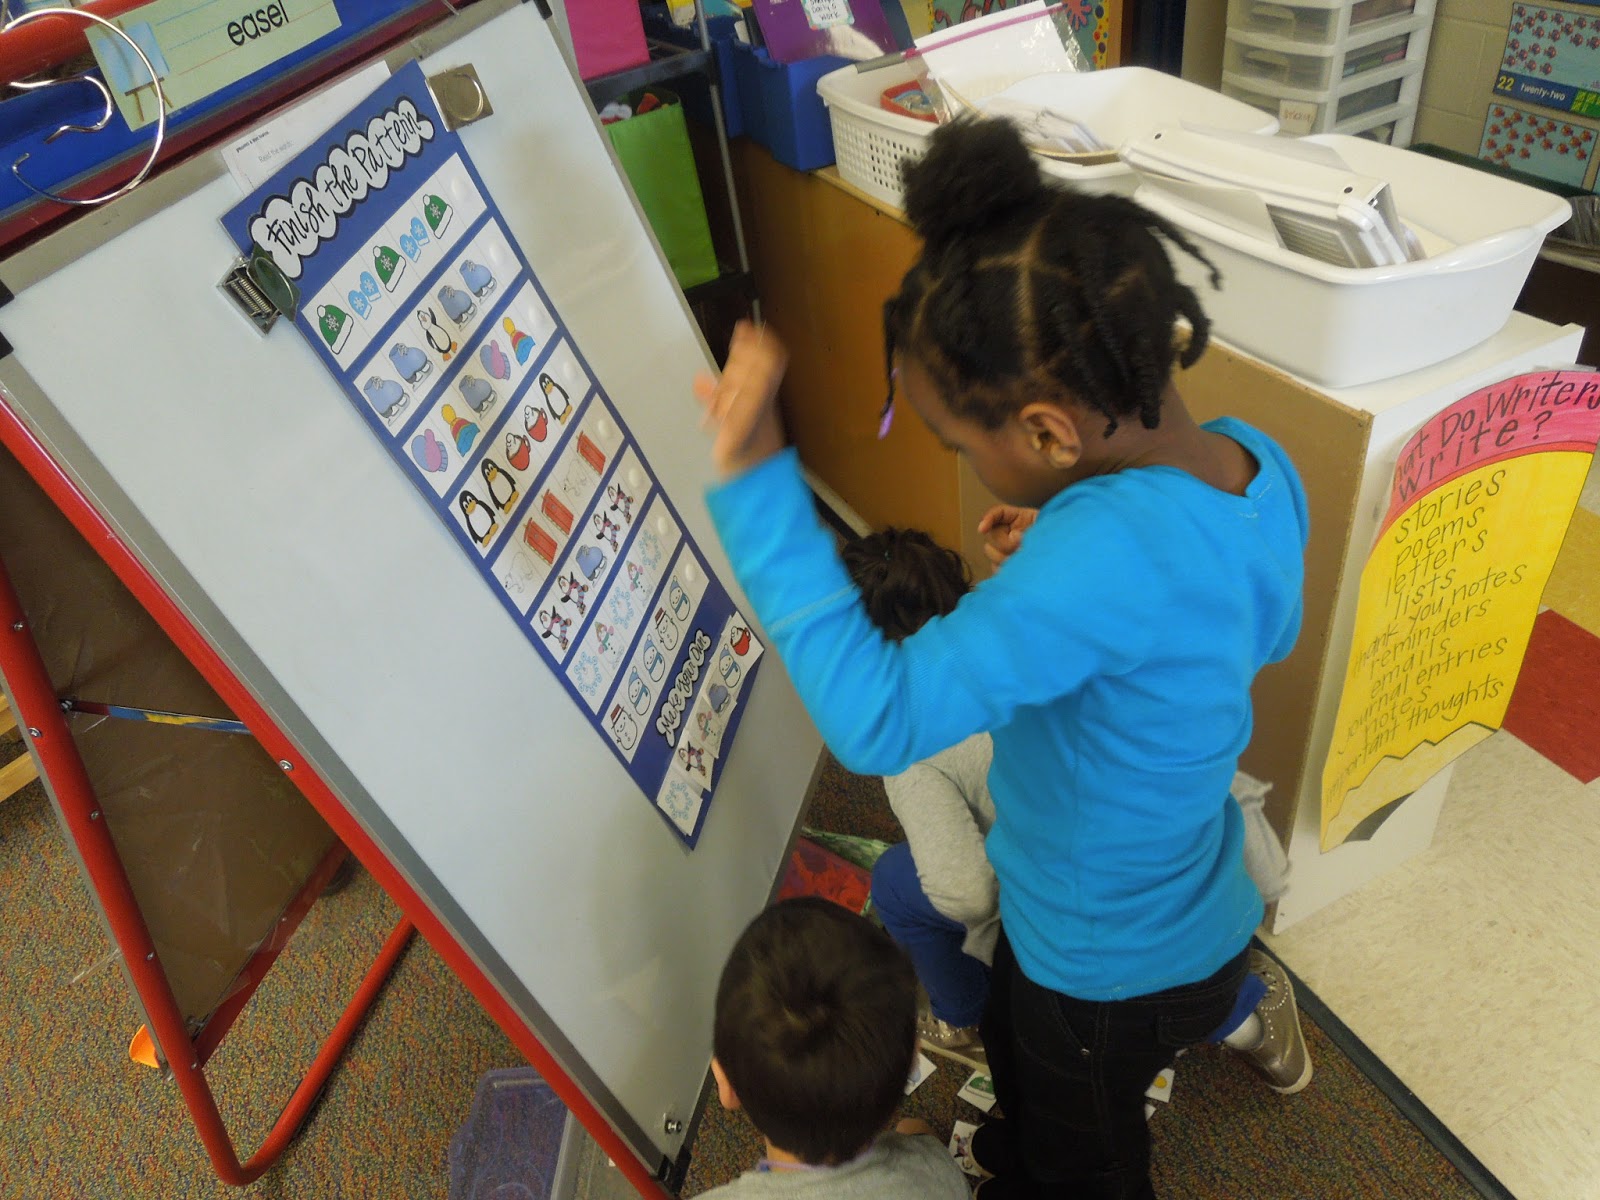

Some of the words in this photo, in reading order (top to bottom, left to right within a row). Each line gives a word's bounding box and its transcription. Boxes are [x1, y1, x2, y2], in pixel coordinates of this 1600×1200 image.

[227, 1, 289, 46] easel
[1497, 75, 1515, 91] 22
[1520, 83, 1566, 101] twenty-two
[266, 187, 330, 255] Finish
[324, 164, 359, 207] the
[350, 110, 422, 180] Pattern
[1441, 408, 1476, 449] Do
[1395, 469, 1506, 544] stories
[1384, 529, 1488, 608] letters
[1395, 506, 1485, 580] poems
[1394, 568, 1457, 620] lists
[1408, 596, 1444, 634] you
[1452, 563, 1528, 606] notes
[1369, 598, 1491, 680] reminders
[1371, 637, 1451, 699] emails
[1416, 636, 1508, 686] entries
[1364, 685, 1432, 742] notes
[1406, 673, 1504, 731] thoughts
